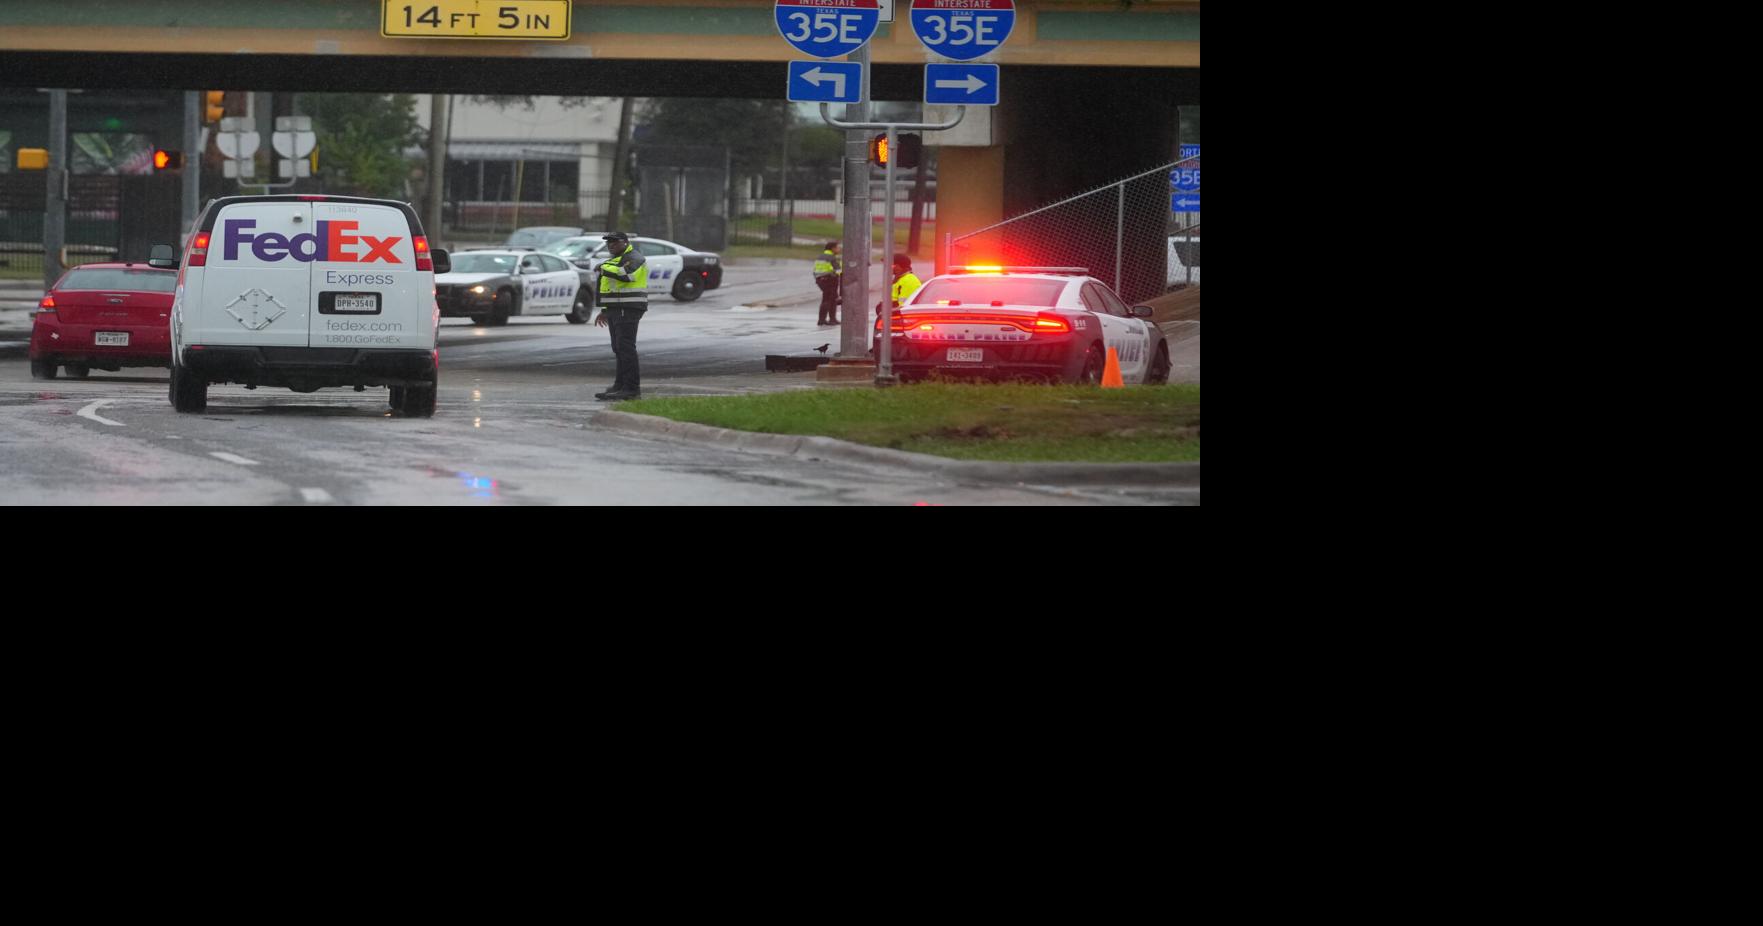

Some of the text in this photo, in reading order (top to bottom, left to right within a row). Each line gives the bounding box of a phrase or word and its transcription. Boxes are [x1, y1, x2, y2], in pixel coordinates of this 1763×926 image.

[934, 0, 991, 8] INTERSTATE
[403, 6, 550, 29] 14 FT 5 IN
[786, 12, 863, 44] 35E
[922, 15, 999, 46] 35E
[223, 219, 403, 264] FedEx
[326, 271, 394, 285] Express
[531, 285, 574, 299] POLICE
[327, 319, 402, 331] fedex.com
